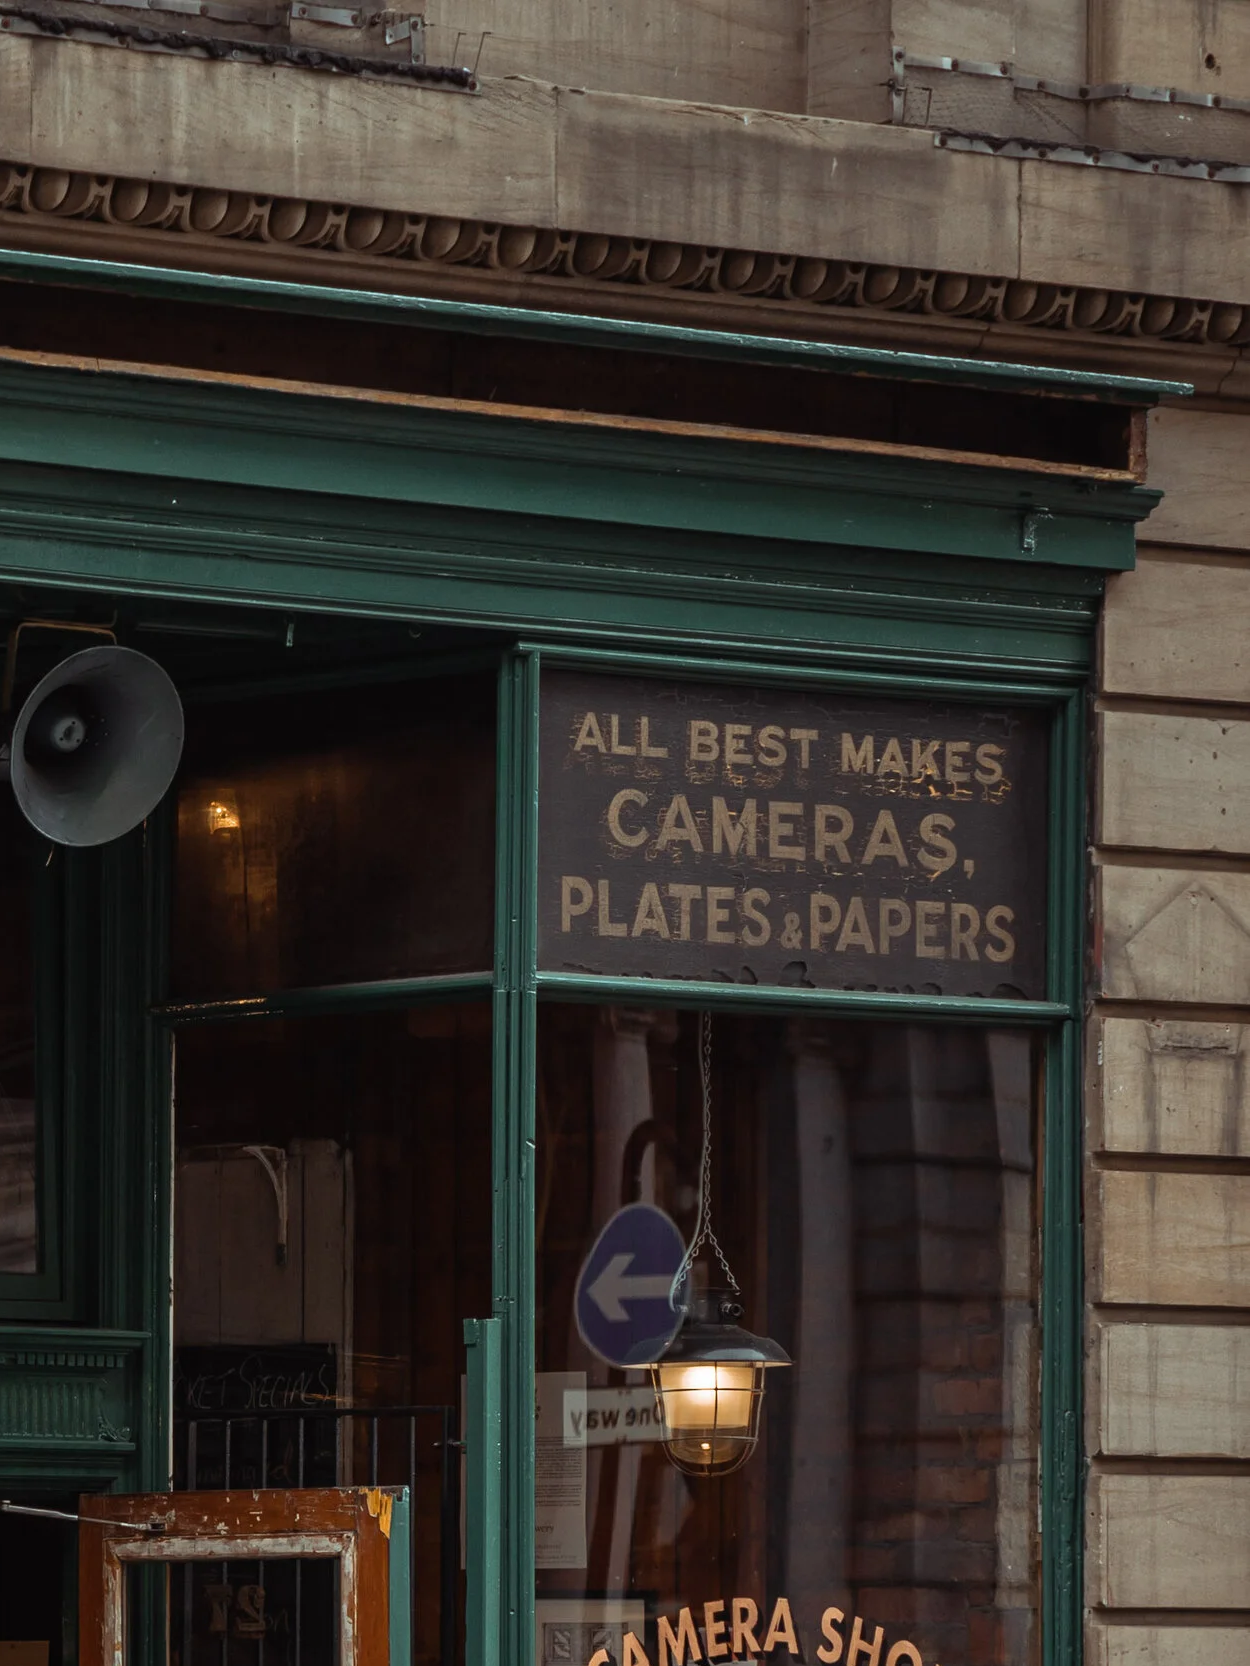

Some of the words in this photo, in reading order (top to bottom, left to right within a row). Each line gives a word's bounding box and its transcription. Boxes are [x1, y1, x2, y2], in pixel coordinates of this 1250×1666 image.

[573, 711, 669, 759] ALL
[688, 720, 819, 770] BEST
[840, 731, 1006, 786] MAKES
[607, 788, 975, 880] CAMERAS,
[561, 875, 771, 948] PLATES
[780, 910, 803, 951] &
[810, 893, 1016, 963] PAPERS
